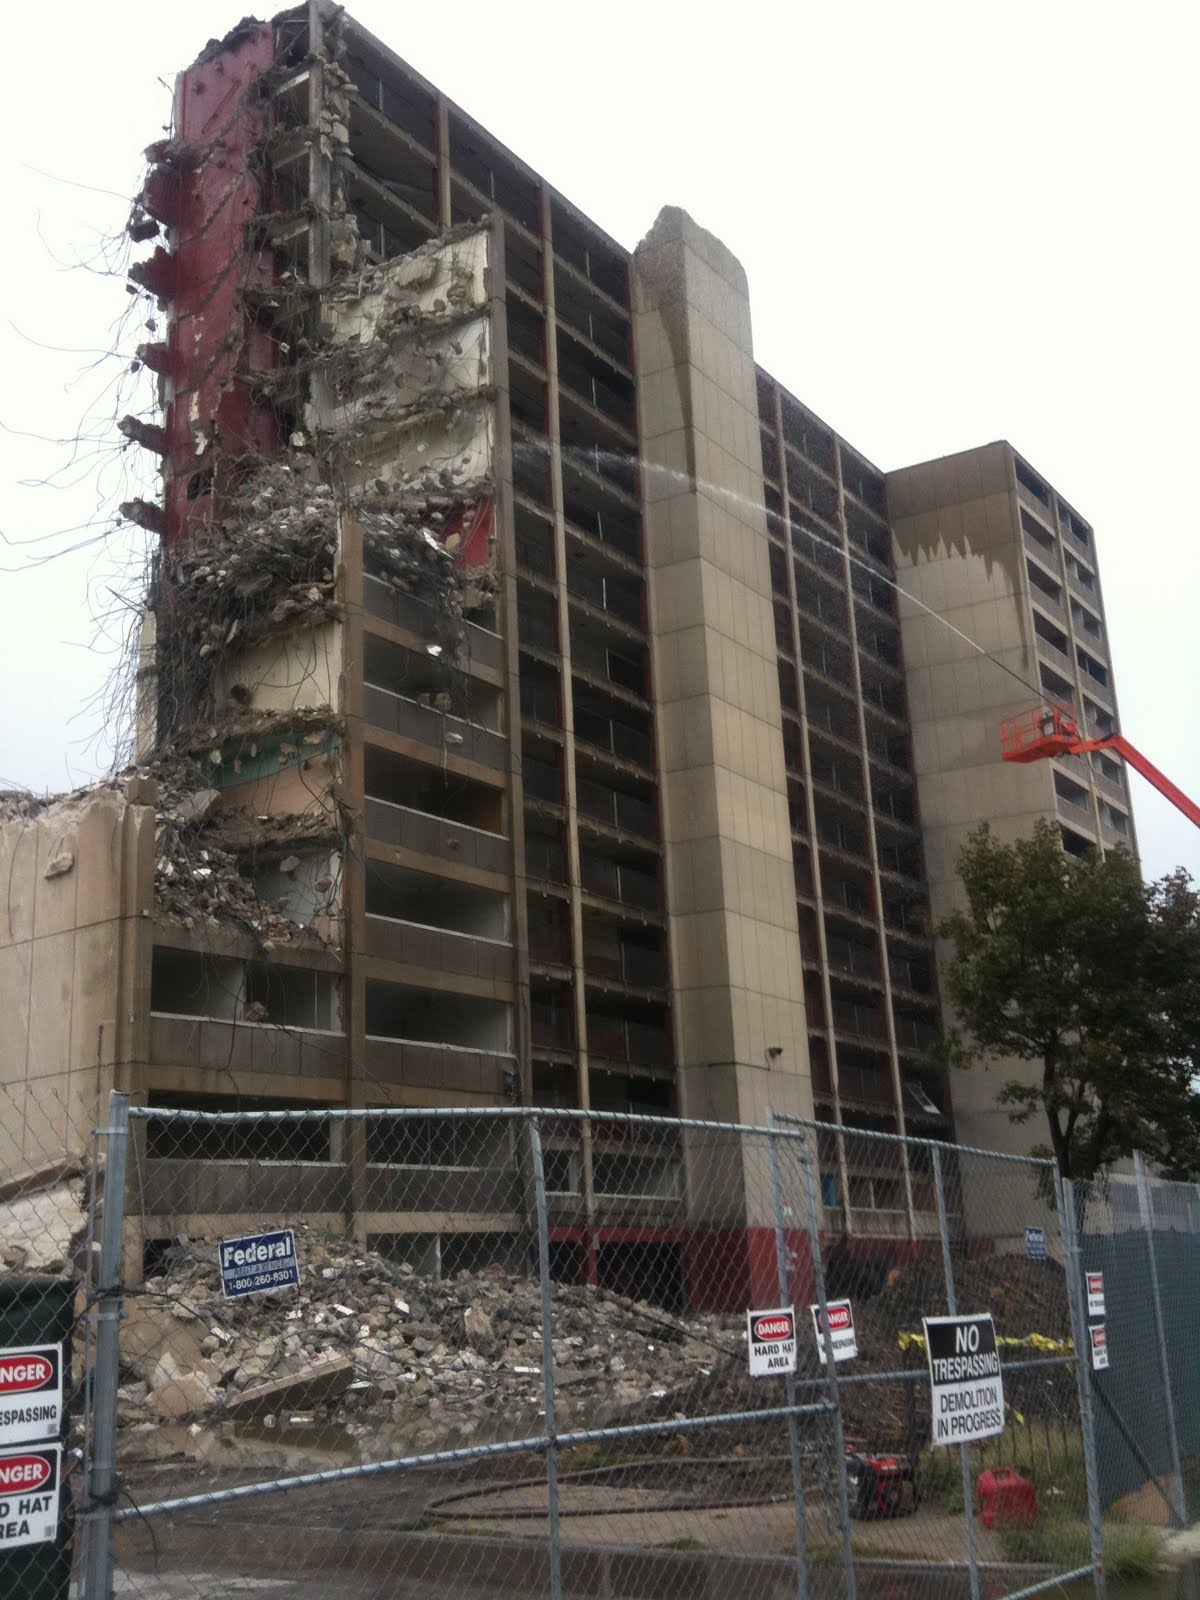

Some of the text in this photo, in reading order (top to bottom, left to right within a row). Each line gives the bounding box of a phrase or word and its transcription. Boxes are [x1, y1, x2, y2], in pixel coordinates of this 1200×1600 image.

[223, 1236, 291, 1267] Federal
[758, 1320, 790, 1336] DANGER
[826, 1311, 849, 1325] ANGER
[754, 1342, 795, 1356] HARD HAT
[955, 1325, 979, 1354] NO
[768, 1356, 790, 1369] AREA
[933, 1352, 998, 1381] TRESPASSING
[940, 1386, 998, 1413] DEMOLITION
[937, 1408, 1001, 1438] IN PROGRESS
[18, 1496, 52, 1516] HAT
